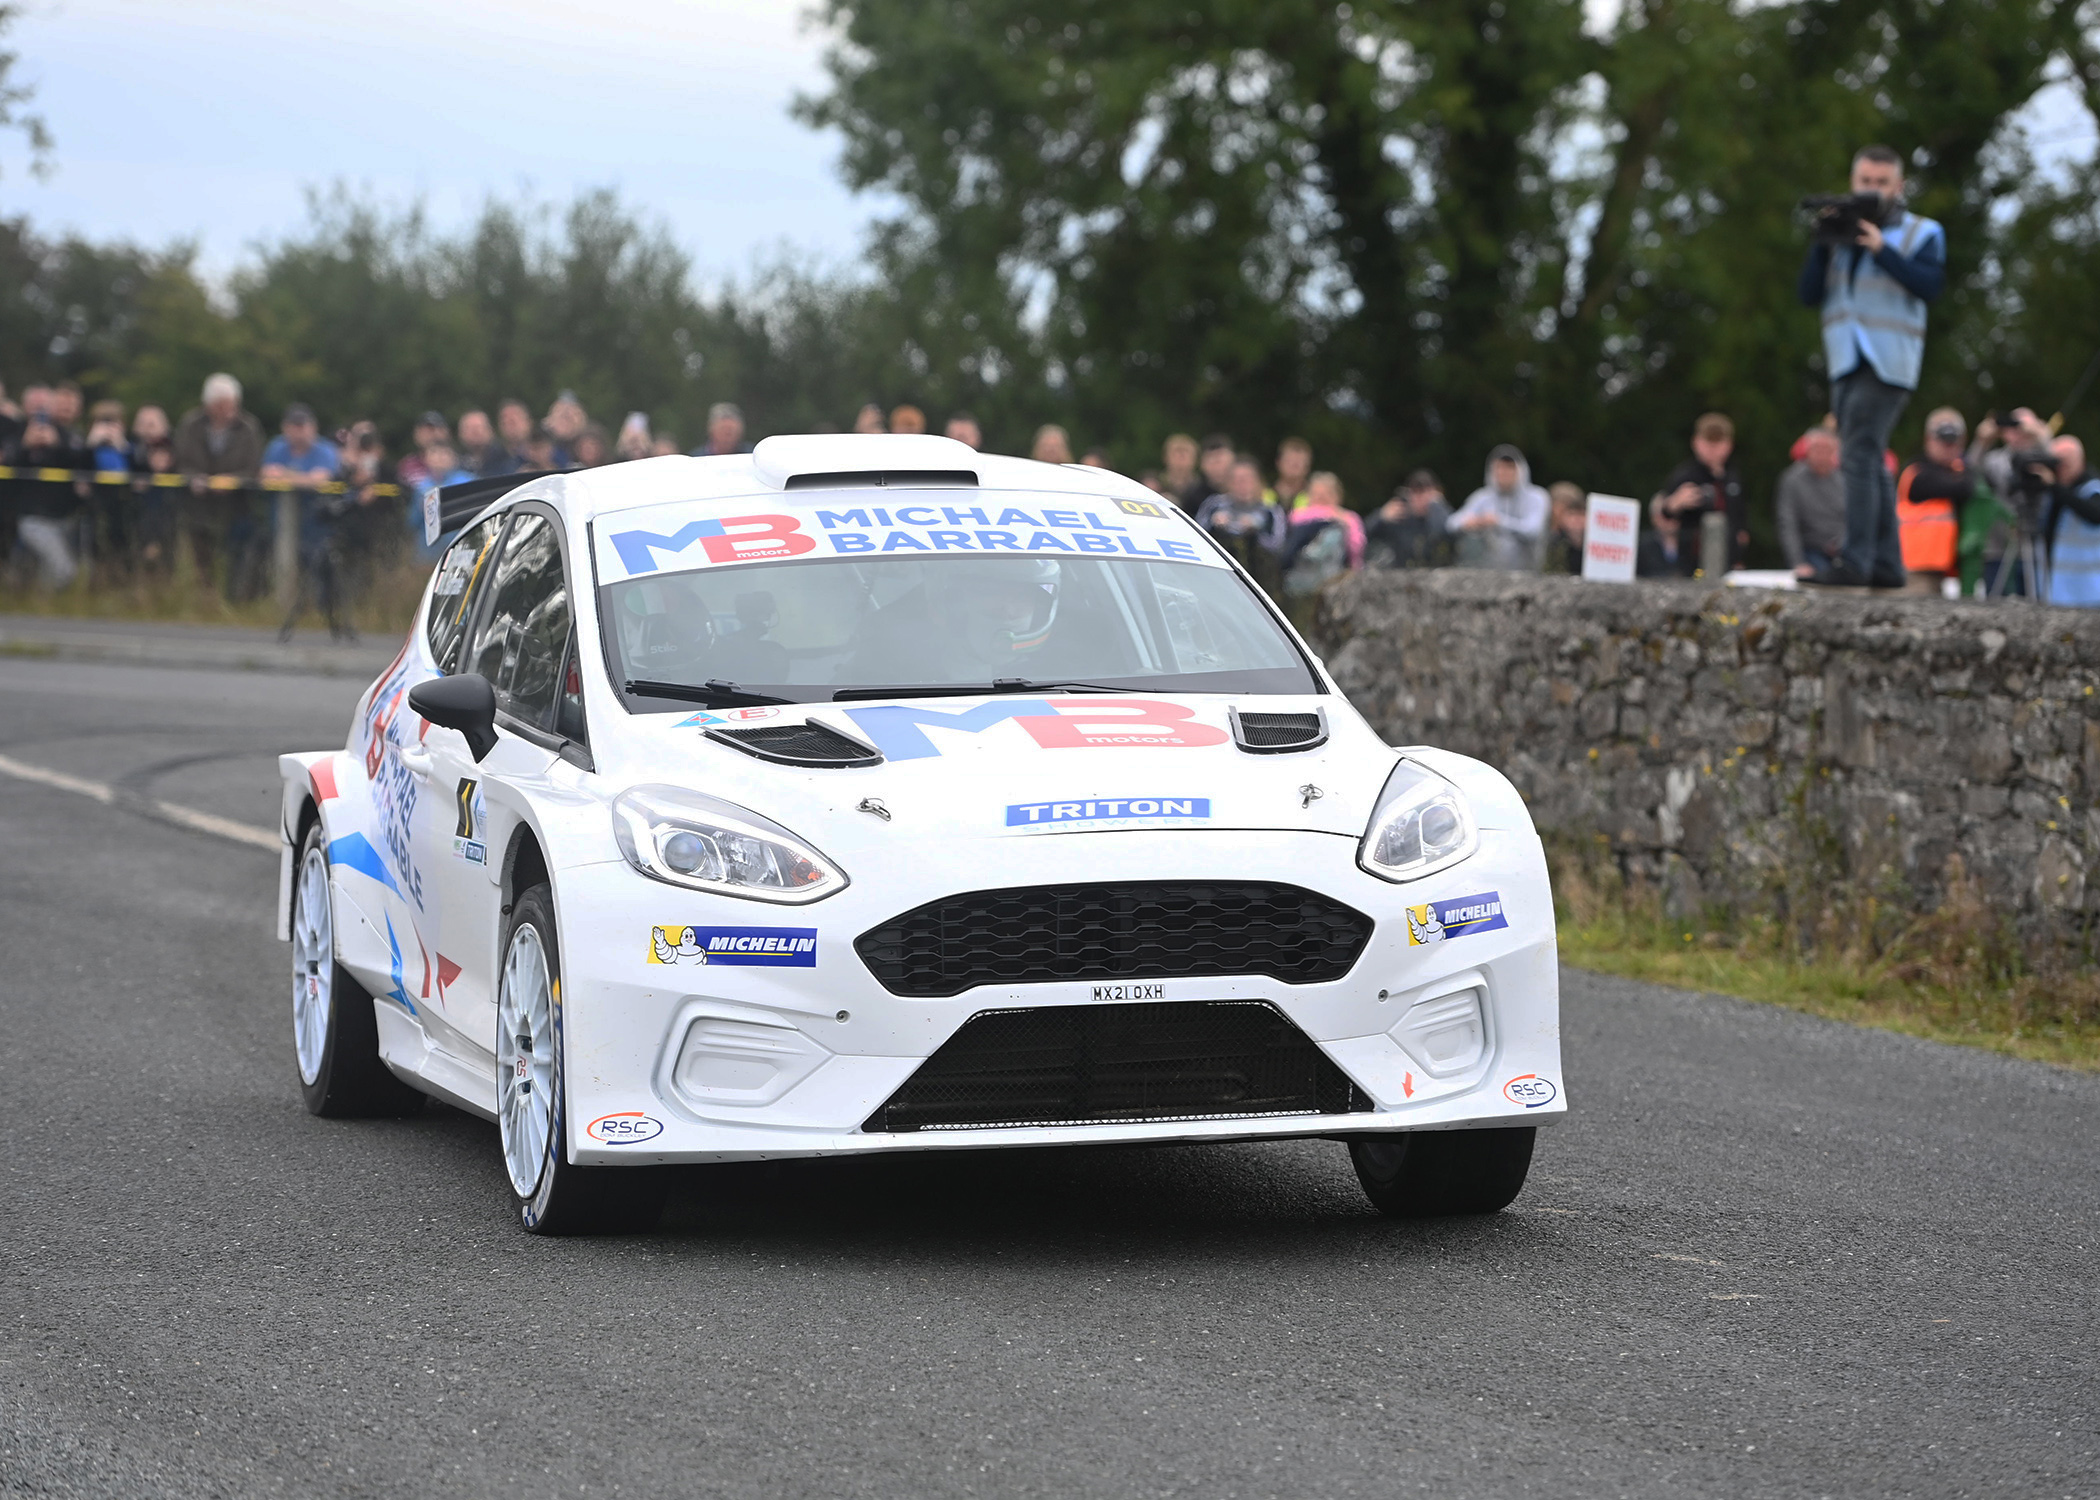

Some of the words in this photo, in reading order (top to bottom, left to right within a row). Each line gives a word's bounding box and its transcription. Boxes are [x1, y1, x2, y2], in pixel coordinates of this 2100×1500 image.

[1121, 500, 1160, 516] 01
[815, 506, 1127, 531] MICHAEL
[609, 514, 816, 575] MB
[828, 530, 1201, 562] BARRABLE
[736, 548, 791, 558] motors
[740, 708, 768, 719] E
[842, 699, 1230, 762] MB
[1086, 735, 1184, 745] motors
[1019, 800, 1192, 821] TRITON
[1022, 817, 1208, 832] SHOWERS
[1444, 901, 1501, 924] MICHELIN
[708, 936, 816, 952] MICHELIN
[1094, 986, 1128, 1000] MX21
[1133, 985, 1163, 999] OXH
[1511, 1083, 1546, 1096] RSC
[601, 1120, 649, 1133] RSC
